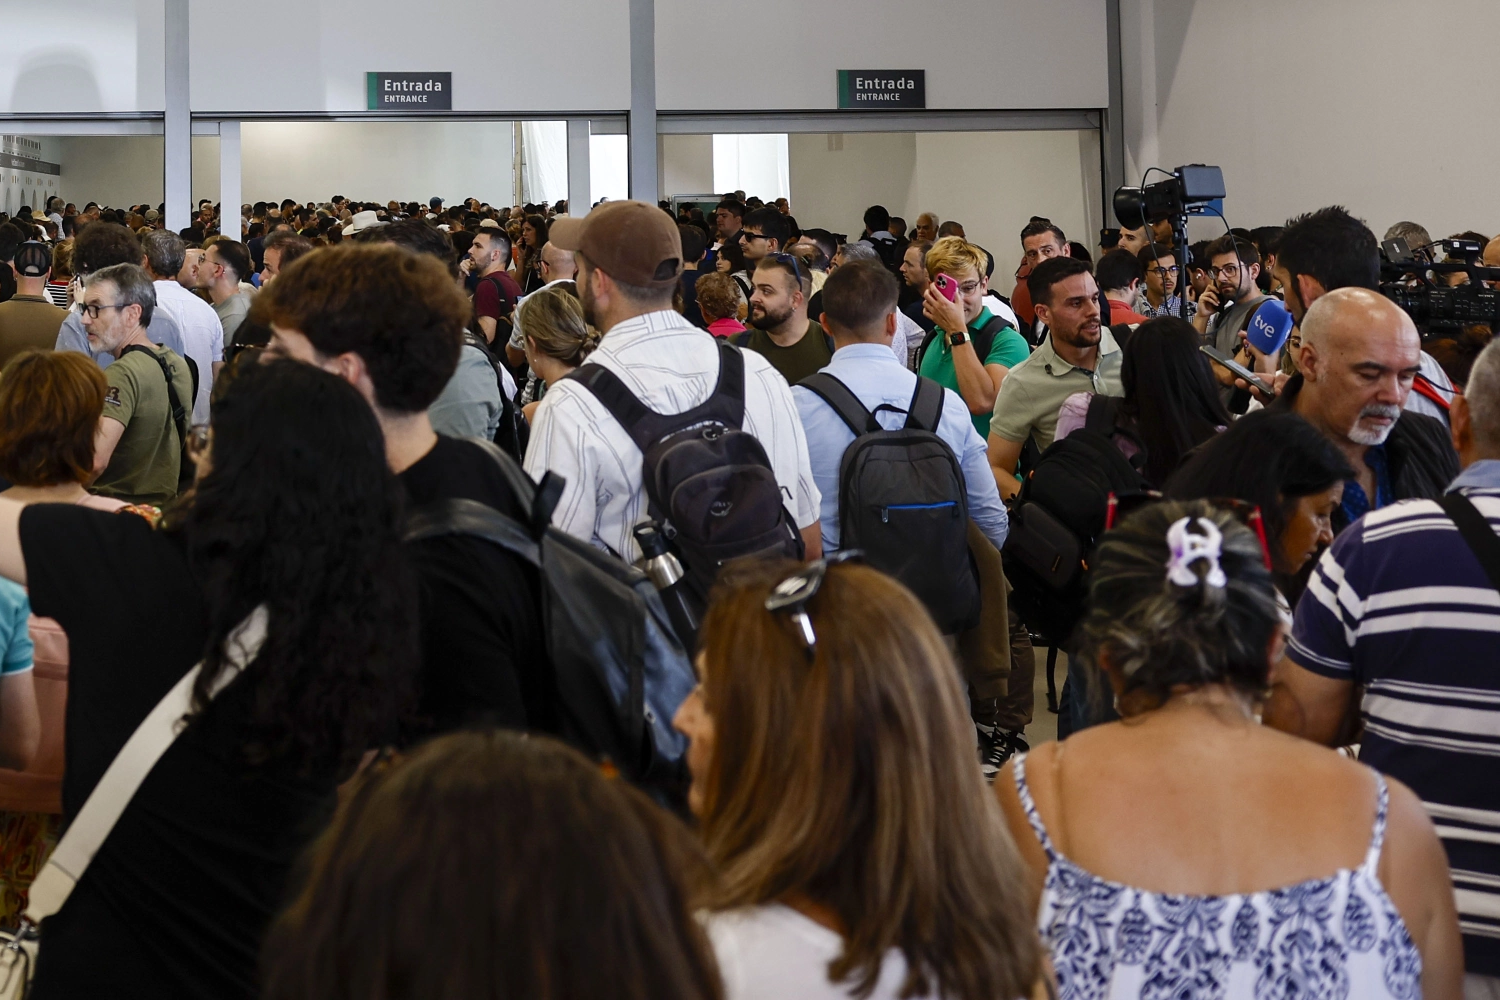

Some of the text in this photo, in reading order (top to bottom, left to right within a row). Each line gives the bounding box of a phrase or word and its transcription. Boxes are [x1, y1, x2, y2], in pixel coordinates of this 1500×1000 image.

[384, 80, 442, 92] Entrada
[856, 78, 915, 90] Entrada
[1254, 314, 1275, 338] tve
